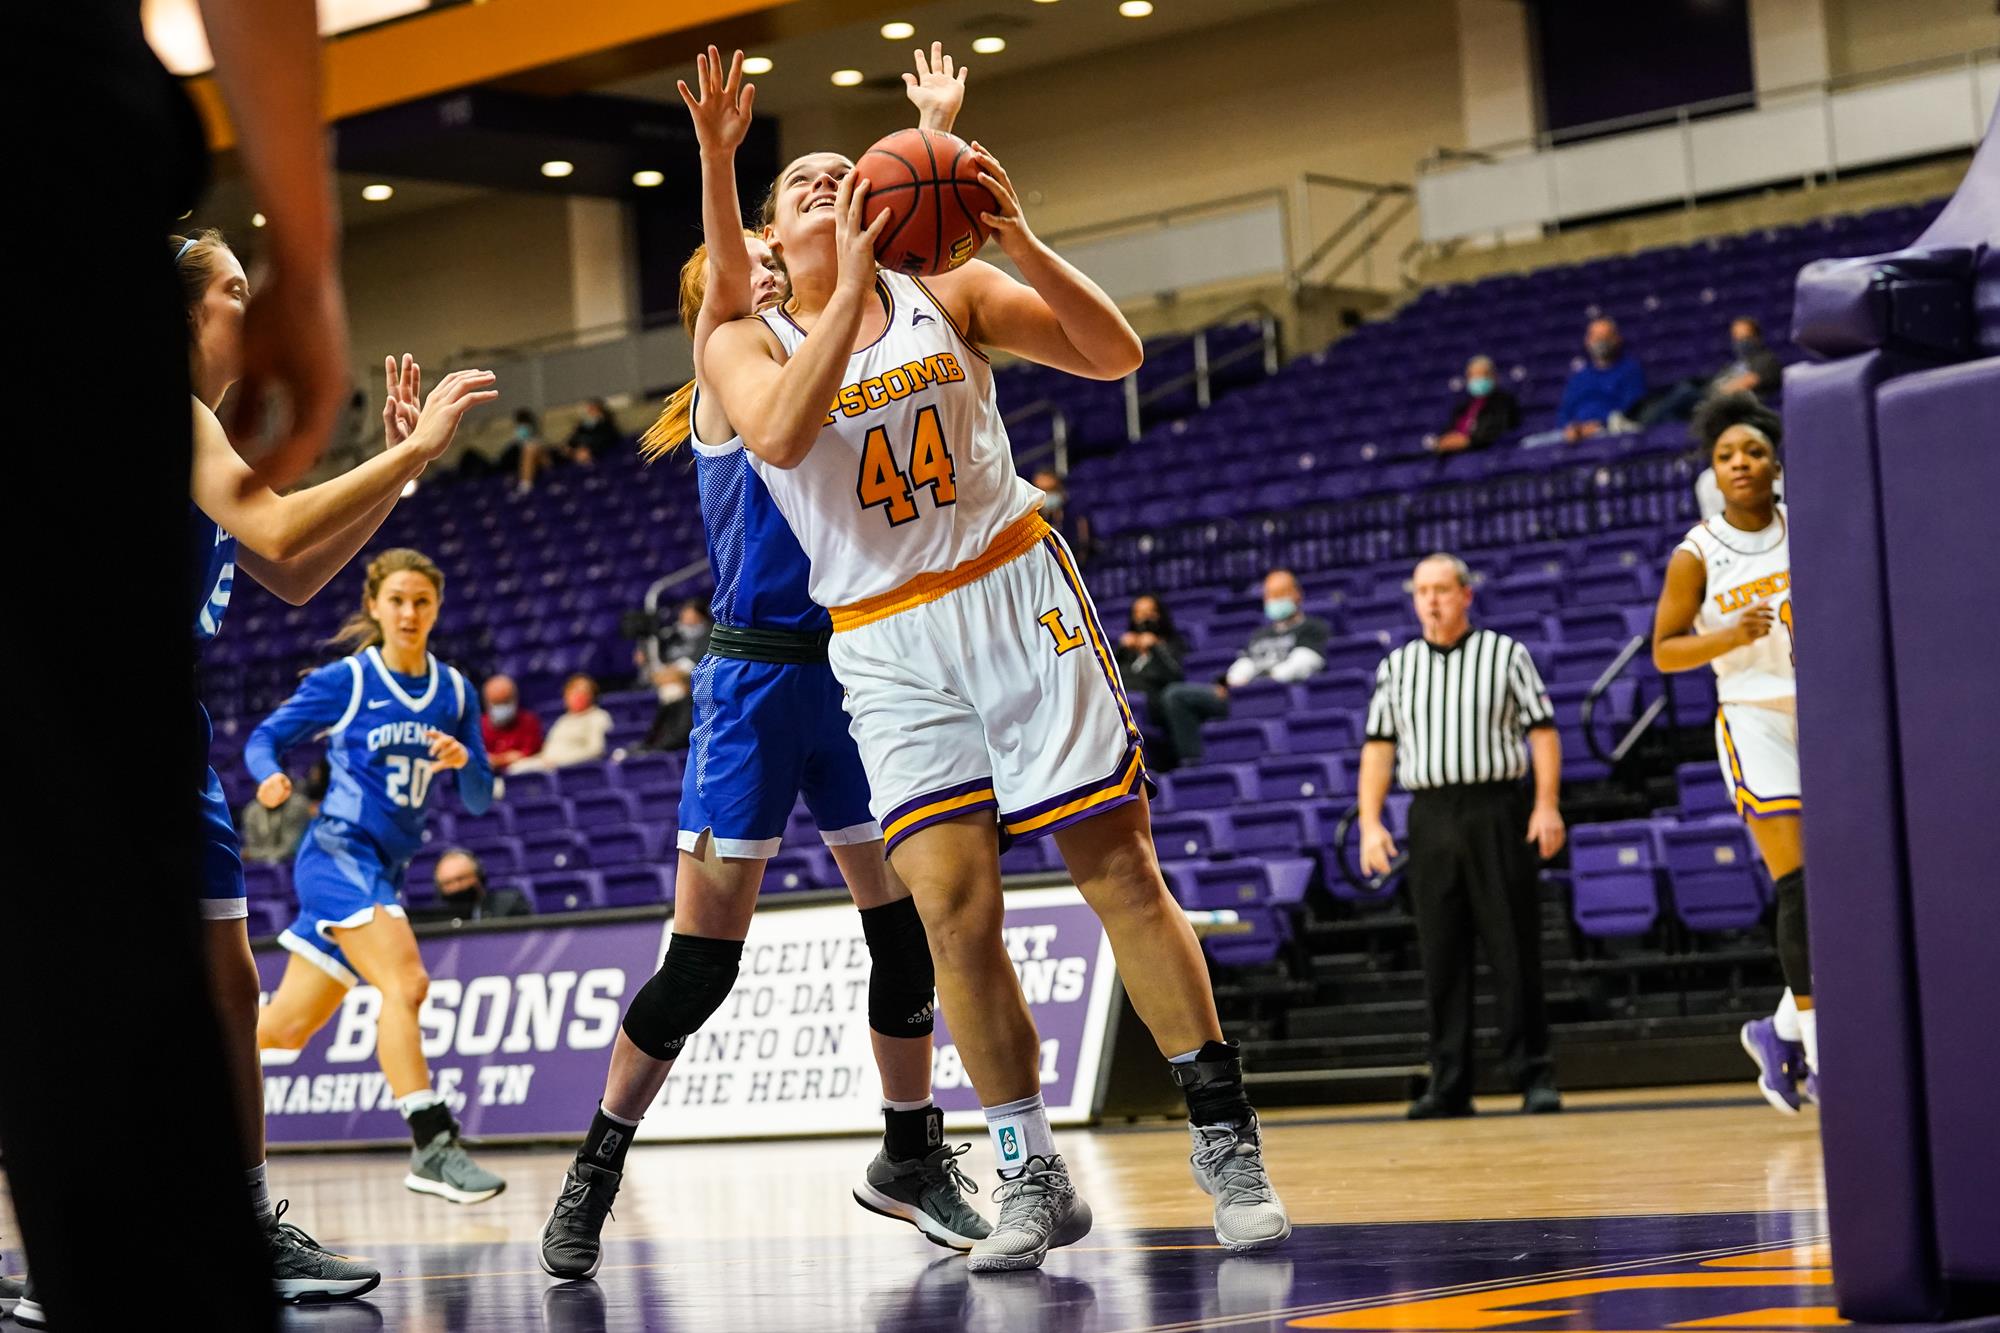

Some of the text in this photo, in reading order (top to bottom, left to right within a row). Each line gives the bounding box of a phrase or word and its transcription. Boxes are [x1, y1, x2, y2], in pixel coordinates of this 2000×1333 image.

[822, 353, 965, 427] SCOMB
[857, 404, 956, 528] 44
[1714, 570, 1791, 614] LIPSC
[1037, 607, 1086, 657] L
[367, 721, 437, 752] COVEN
[386, 754, 433, 809] 20
[740, 937, 866, 977] CEIVE
[325, 968, 626, 1064] BSONS
[732, 980, 867, 1019] TO-DAT
[688, 1023, 844, 1063] INFO ON
[263, 1064, 535, 1115] NASHVIE, TN
[661, 1065, 864, 1107] THE HERD!
